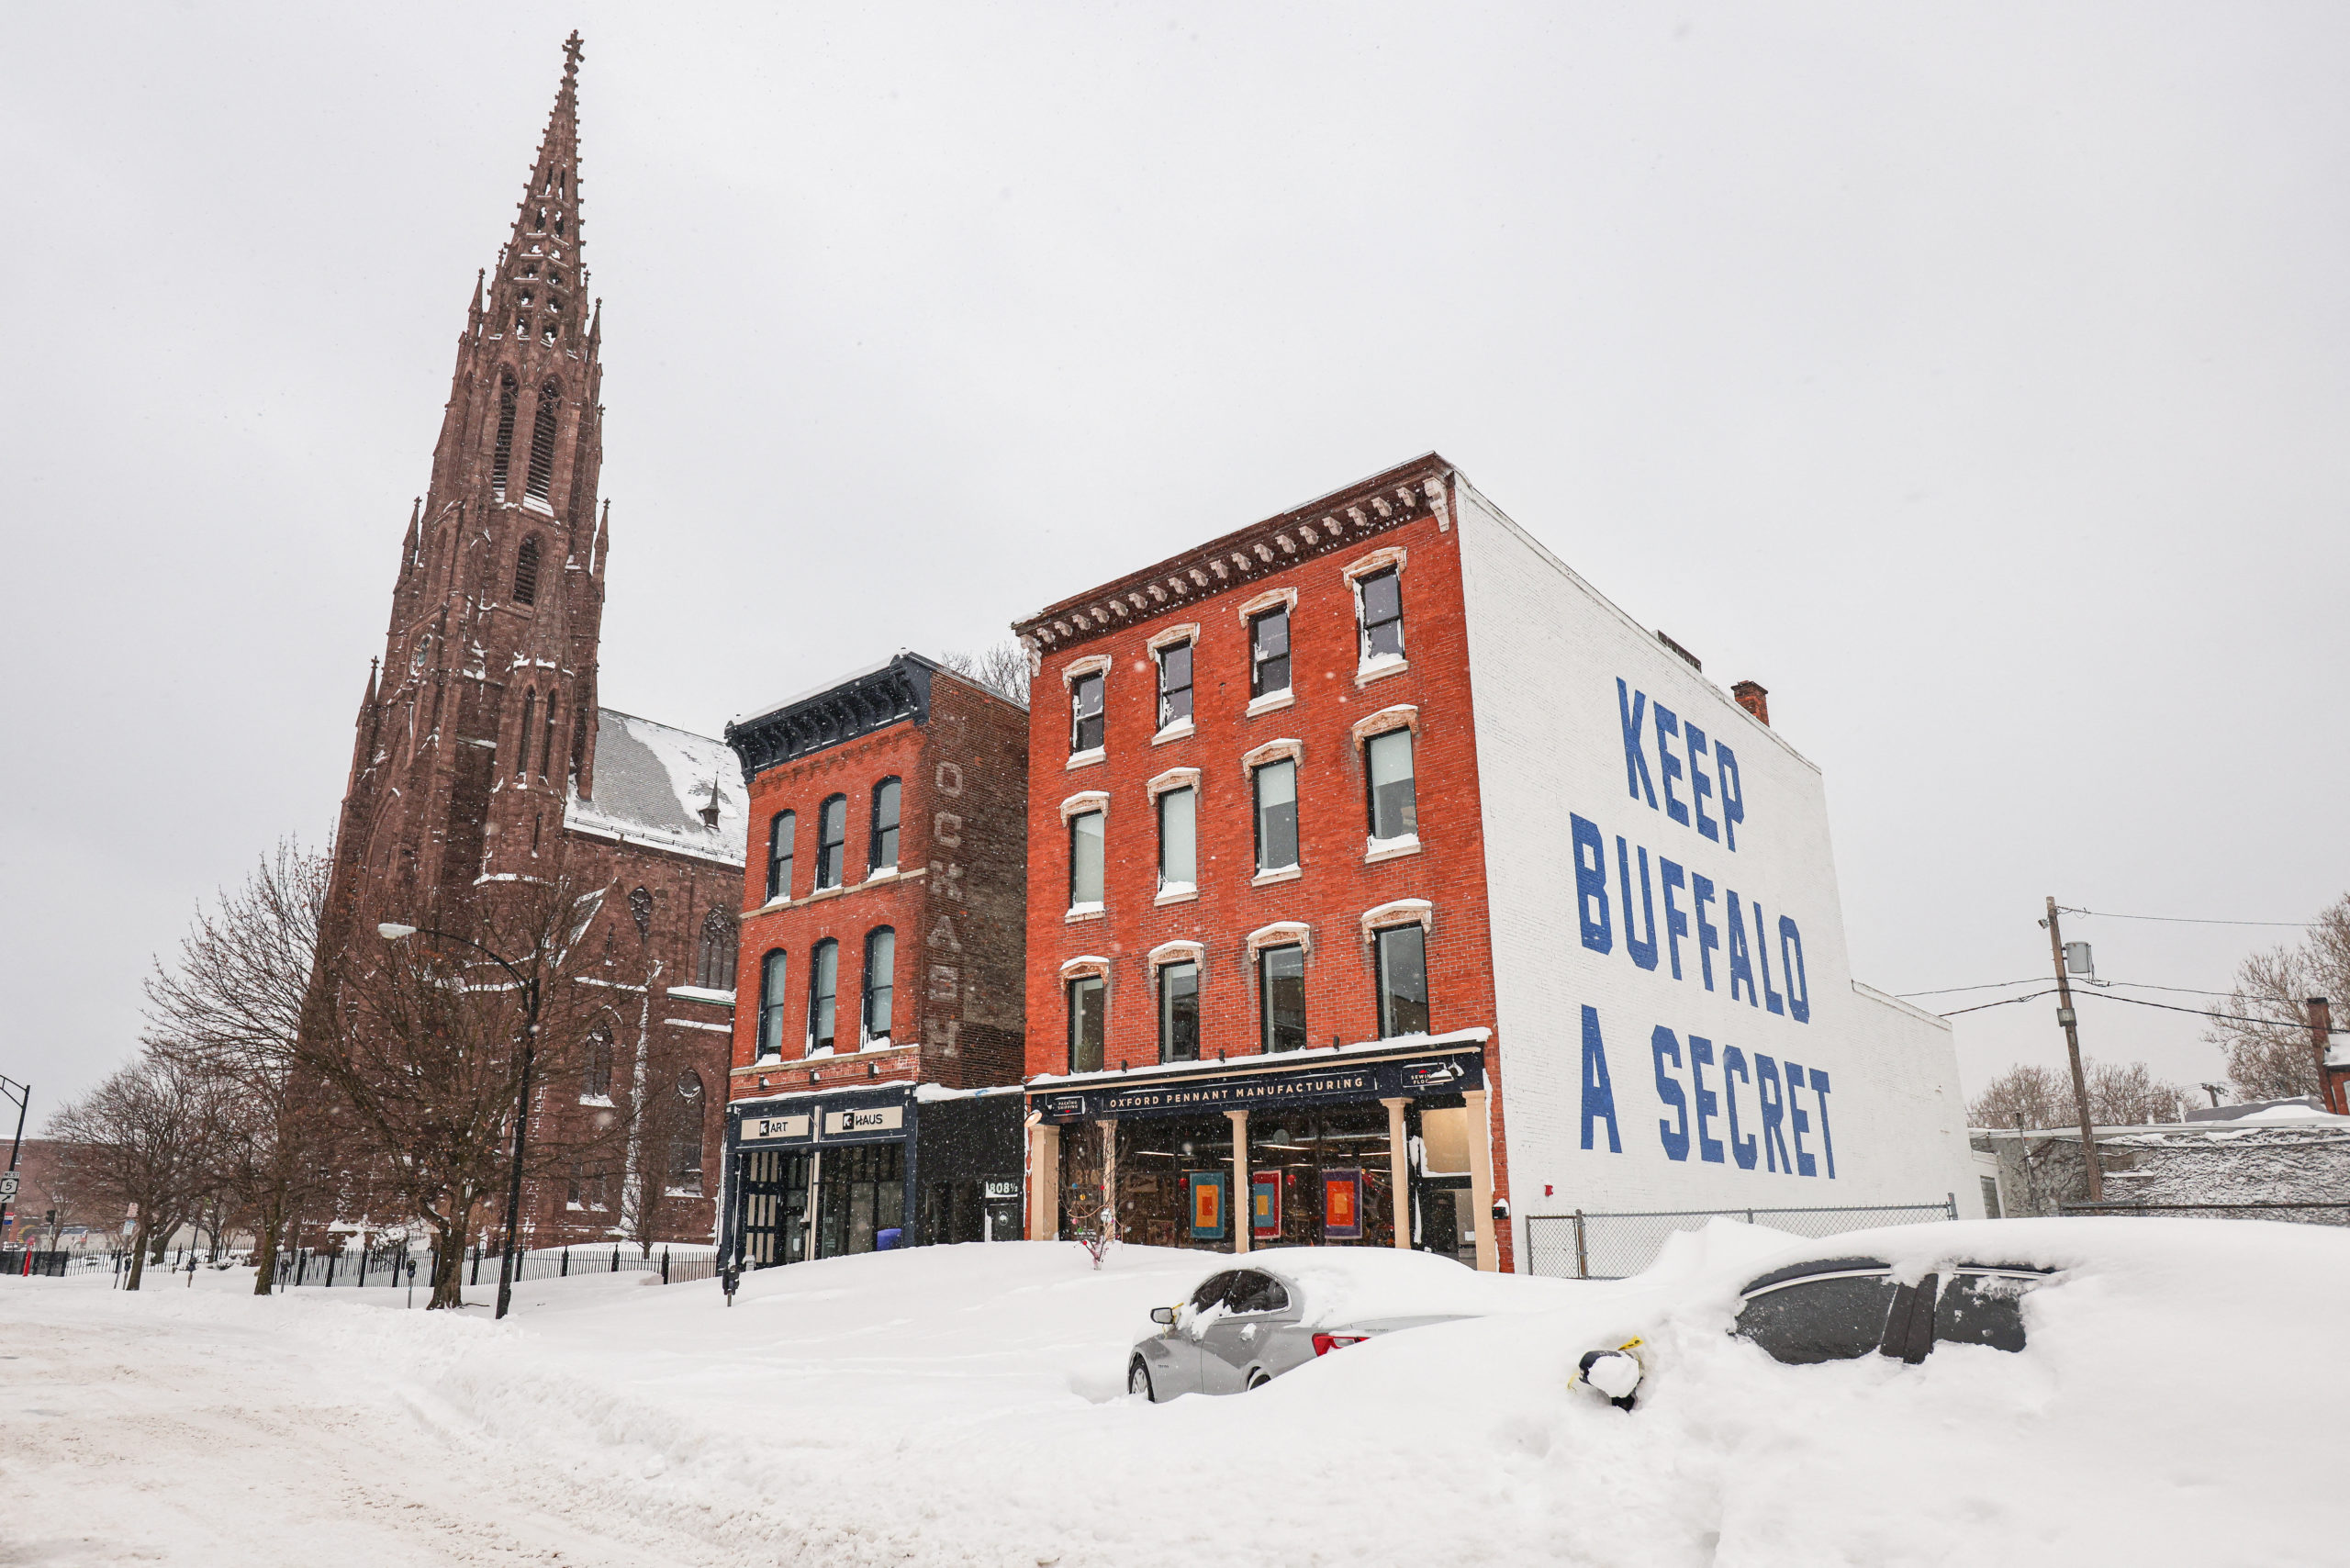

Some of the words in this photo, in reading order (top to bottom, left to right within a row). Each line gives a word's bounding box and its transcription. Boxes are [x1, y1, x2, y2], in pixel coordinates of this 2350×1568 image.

[1617, 677, 1745, 852] KEEP
[1570, 812, 1810, 1024] BUFFALO
[1110, 1096, 1158, 1108] OXFORD
[1167, 1090, 1228, 1103] PENNANT
[1236, 1078, 1363, 1098] MANUFACTURING
[1581, 1004, 1622, 1153] A
[1651, 1024, 1836, 1180] SECRET
[770, 1122, 789, 1133] ART
[856, 1114, 883, 1126] HAUS
[6, 1182, 13, 1190] 5
